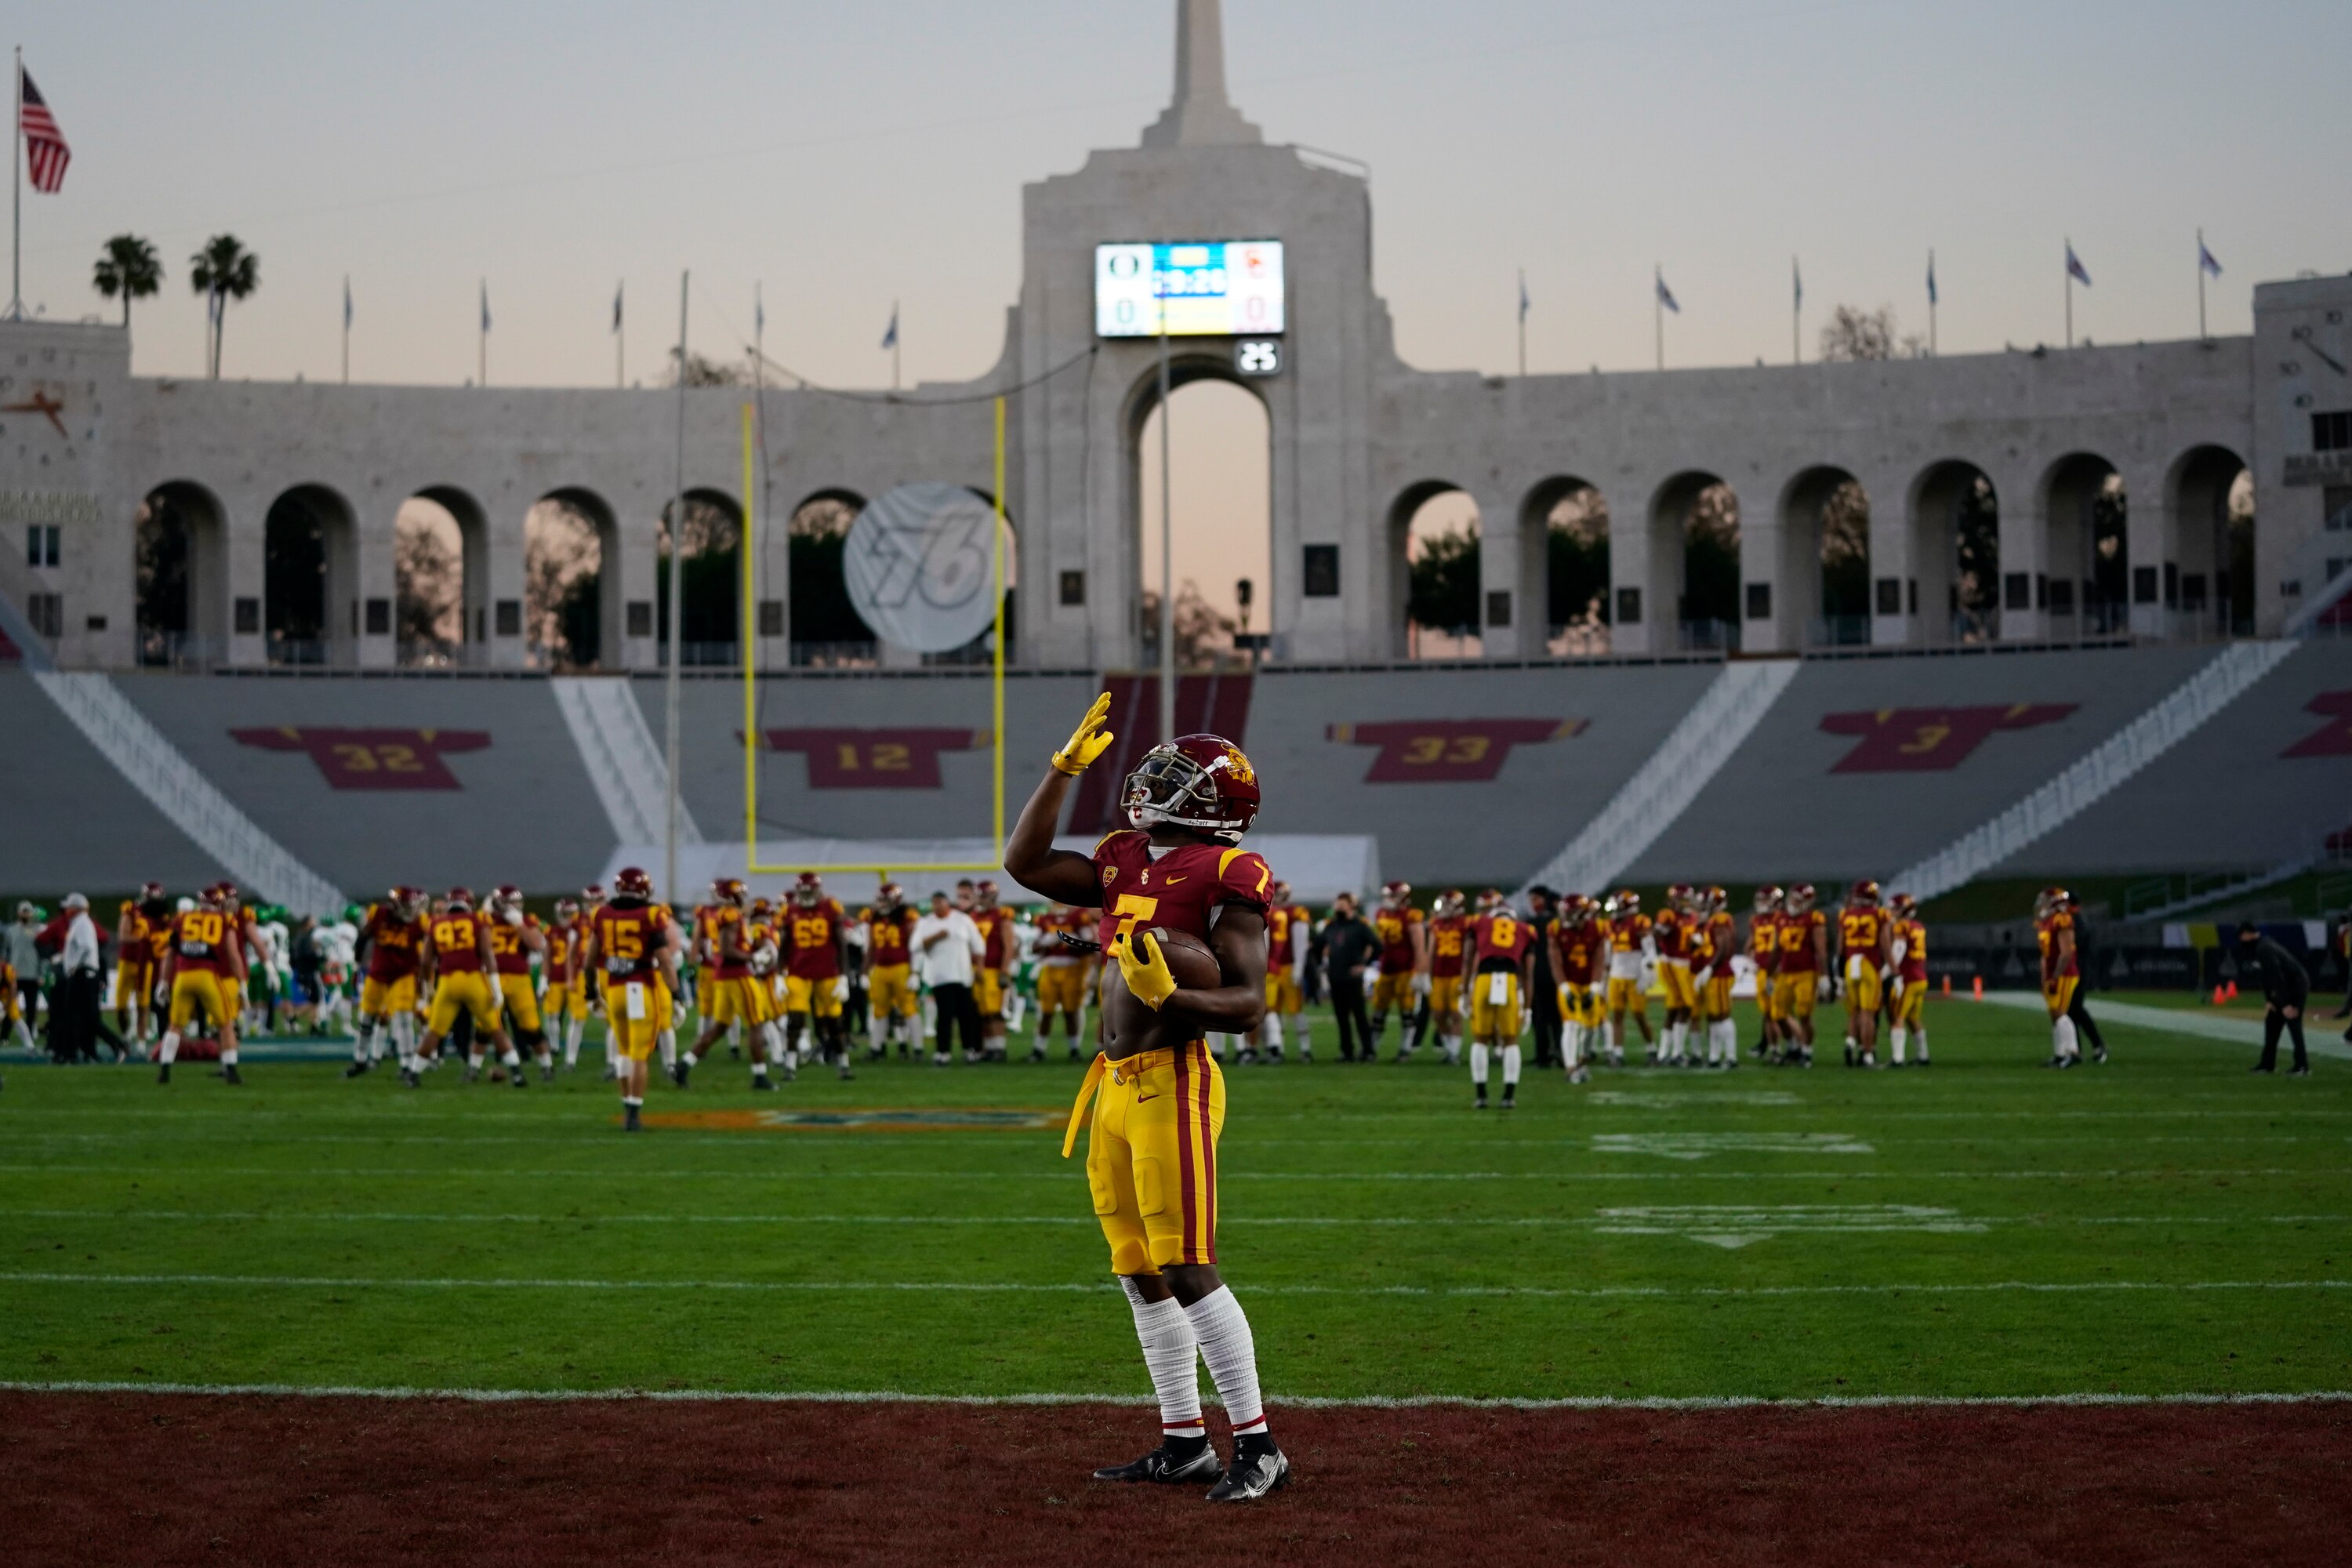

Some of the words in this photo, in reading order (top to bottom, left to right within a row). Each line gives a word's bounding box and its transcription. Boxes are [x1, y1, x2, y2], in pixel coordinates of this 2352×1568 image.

[868, 511, 987, 609] 76
[1400, 735, 1491, 764] 33
[1898, 724, 1951, 754] 3
[332, 742, 427, 772] 32
[837, 742, 912, 771] 12
[181, 911, 223, 946] 50
[433, 917, 476, 953] 93
[601, 919, 643, 959] 15
[1107, 893, 1158, 957] 7
[1490, 917, 1516, 948] 8
[1843, 914, 1878, 947] 23
[1567, 943, 1588, 968] 4
